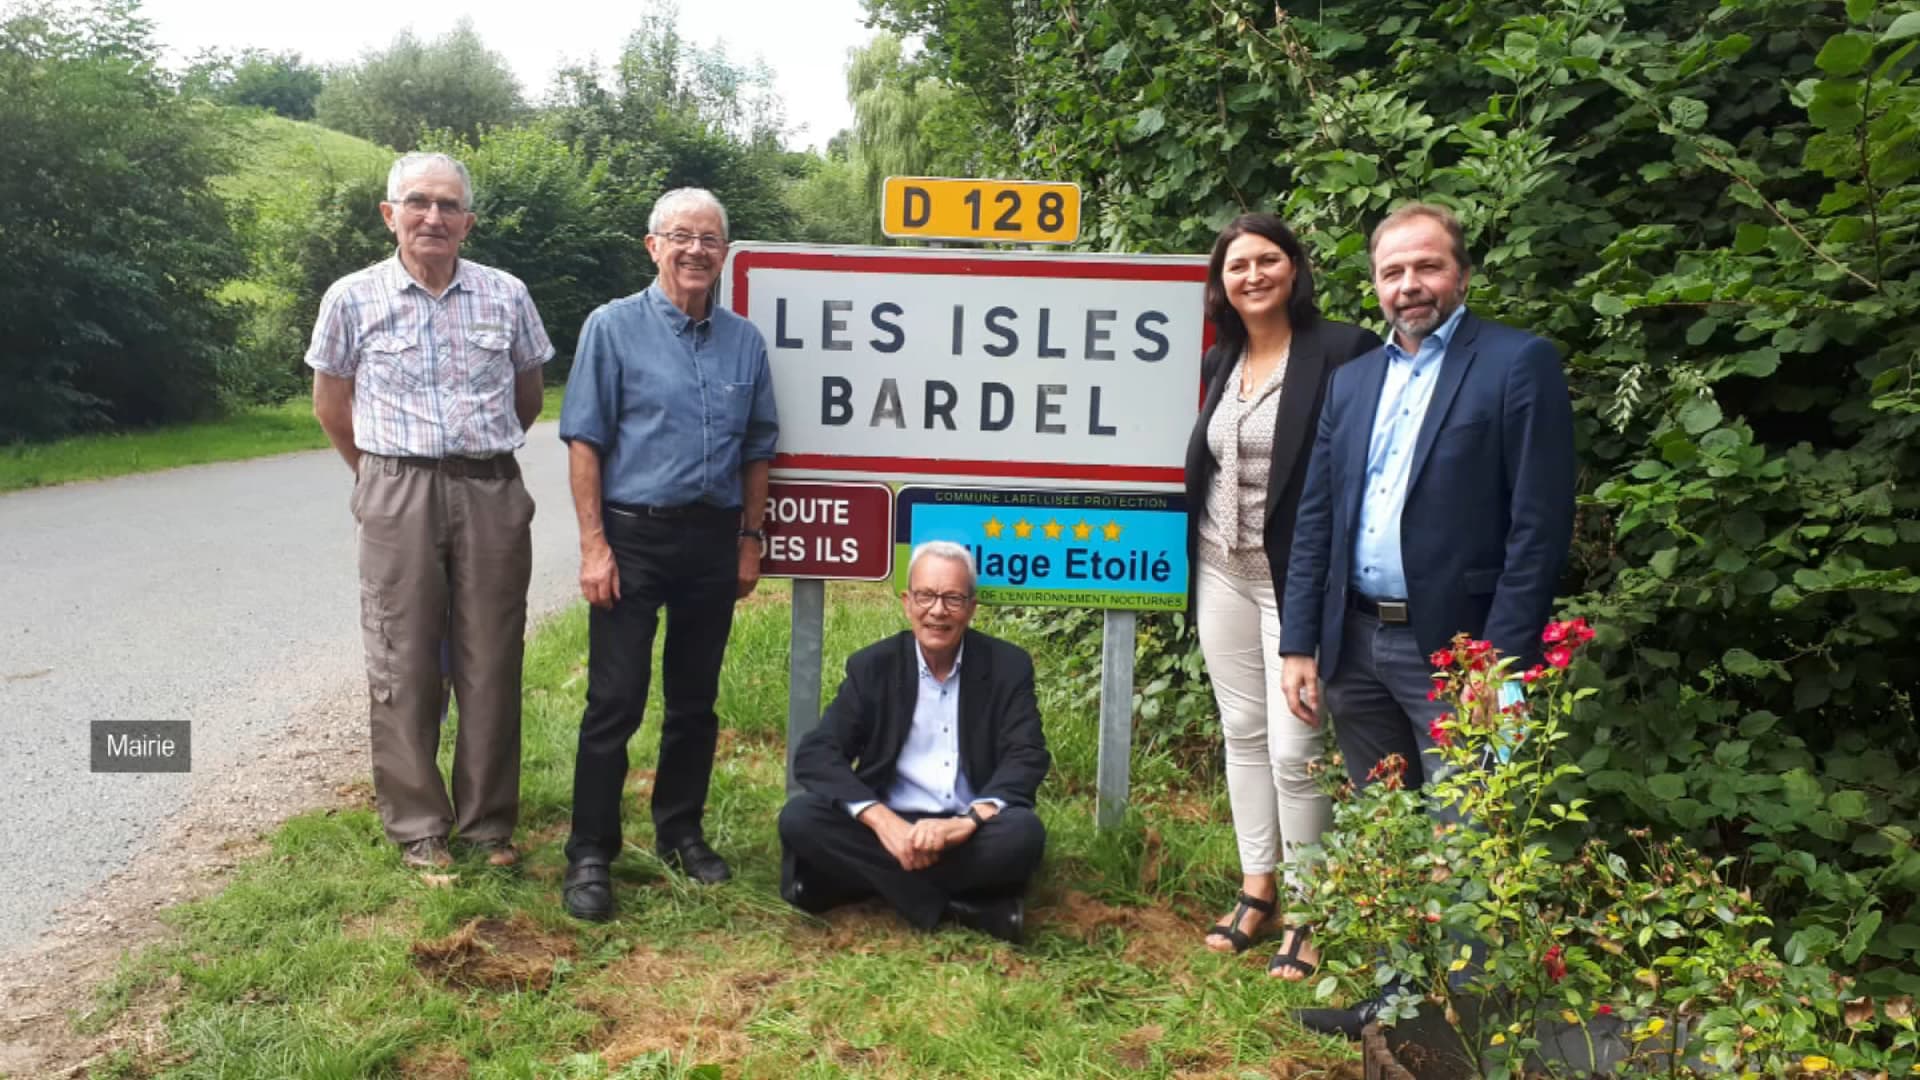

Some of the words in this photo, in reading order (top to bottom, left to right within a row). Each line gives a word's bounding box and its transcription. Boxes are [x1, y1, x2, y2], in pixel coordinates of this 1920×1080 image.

[903, 186, 931, 228] D
[964, 188, 1065, 233] 128
[776, 297, 905, 353] LES
[952, 304, 1170, 362] ISLES
[821, 376, 1117, 436] BARDEL
[762, 497, 849, 525] ROUTE
[935, 491, 1000, 503] COMMUNE
[1084, 495, 1168, 508] PROTECTION
[816, 537, 859, 563] ILS
[1065, 547, 1171, 582] Etoilé
[980, 589, 997, 600] DE
[1000, 591, 1107, 604] L'ENVIRONNEMENT
[1110, 595, 1183, 607] NOCTURNES
